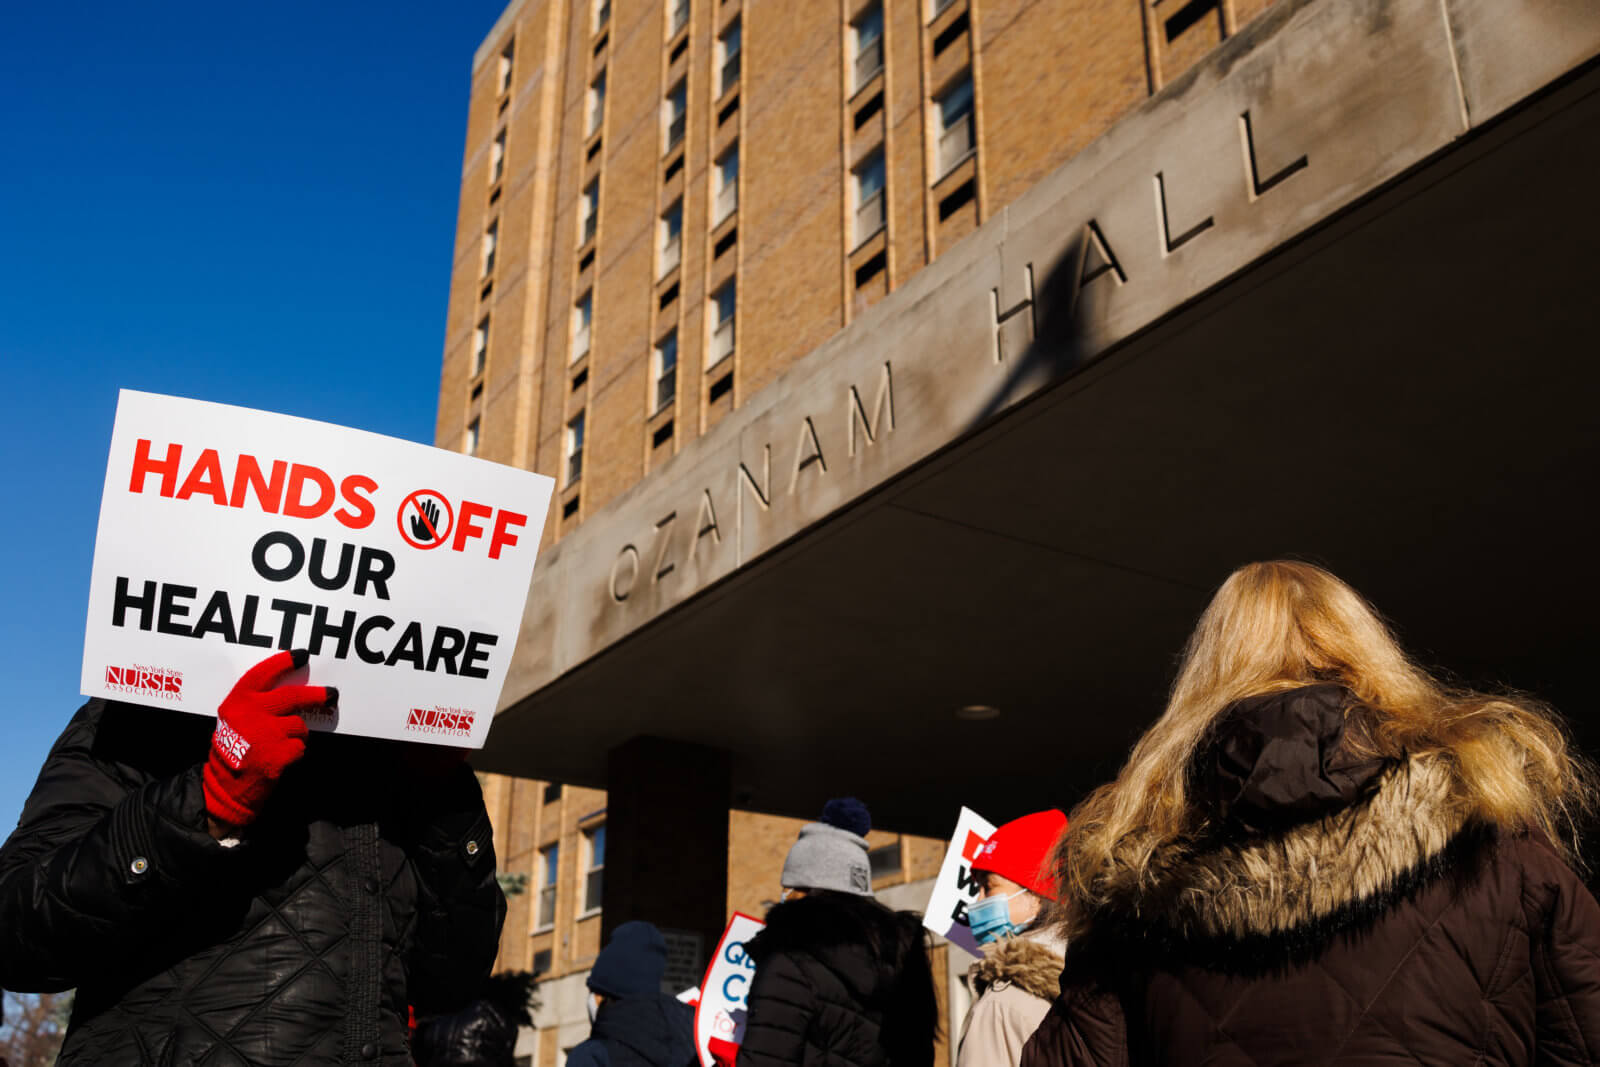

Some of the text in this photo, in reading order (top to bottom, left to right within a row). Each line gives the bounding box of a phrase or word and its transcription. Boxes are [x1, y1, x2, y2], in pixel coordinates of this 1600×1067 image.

[609, 109, 1308, 604] OZANAM HALL
[129, 439, 528, 560] HANDS OFF
[252, 531, 395, 600] OUR
[112, 577, 498, 680] HEALTHCARE
[105, 665, 183, 694] NURSES
[105, 684, 183, 701] ASSOCIATION
[404, 726, 471, 737] ASSOCIATION
[407, 709, 474, 731] NURSES
